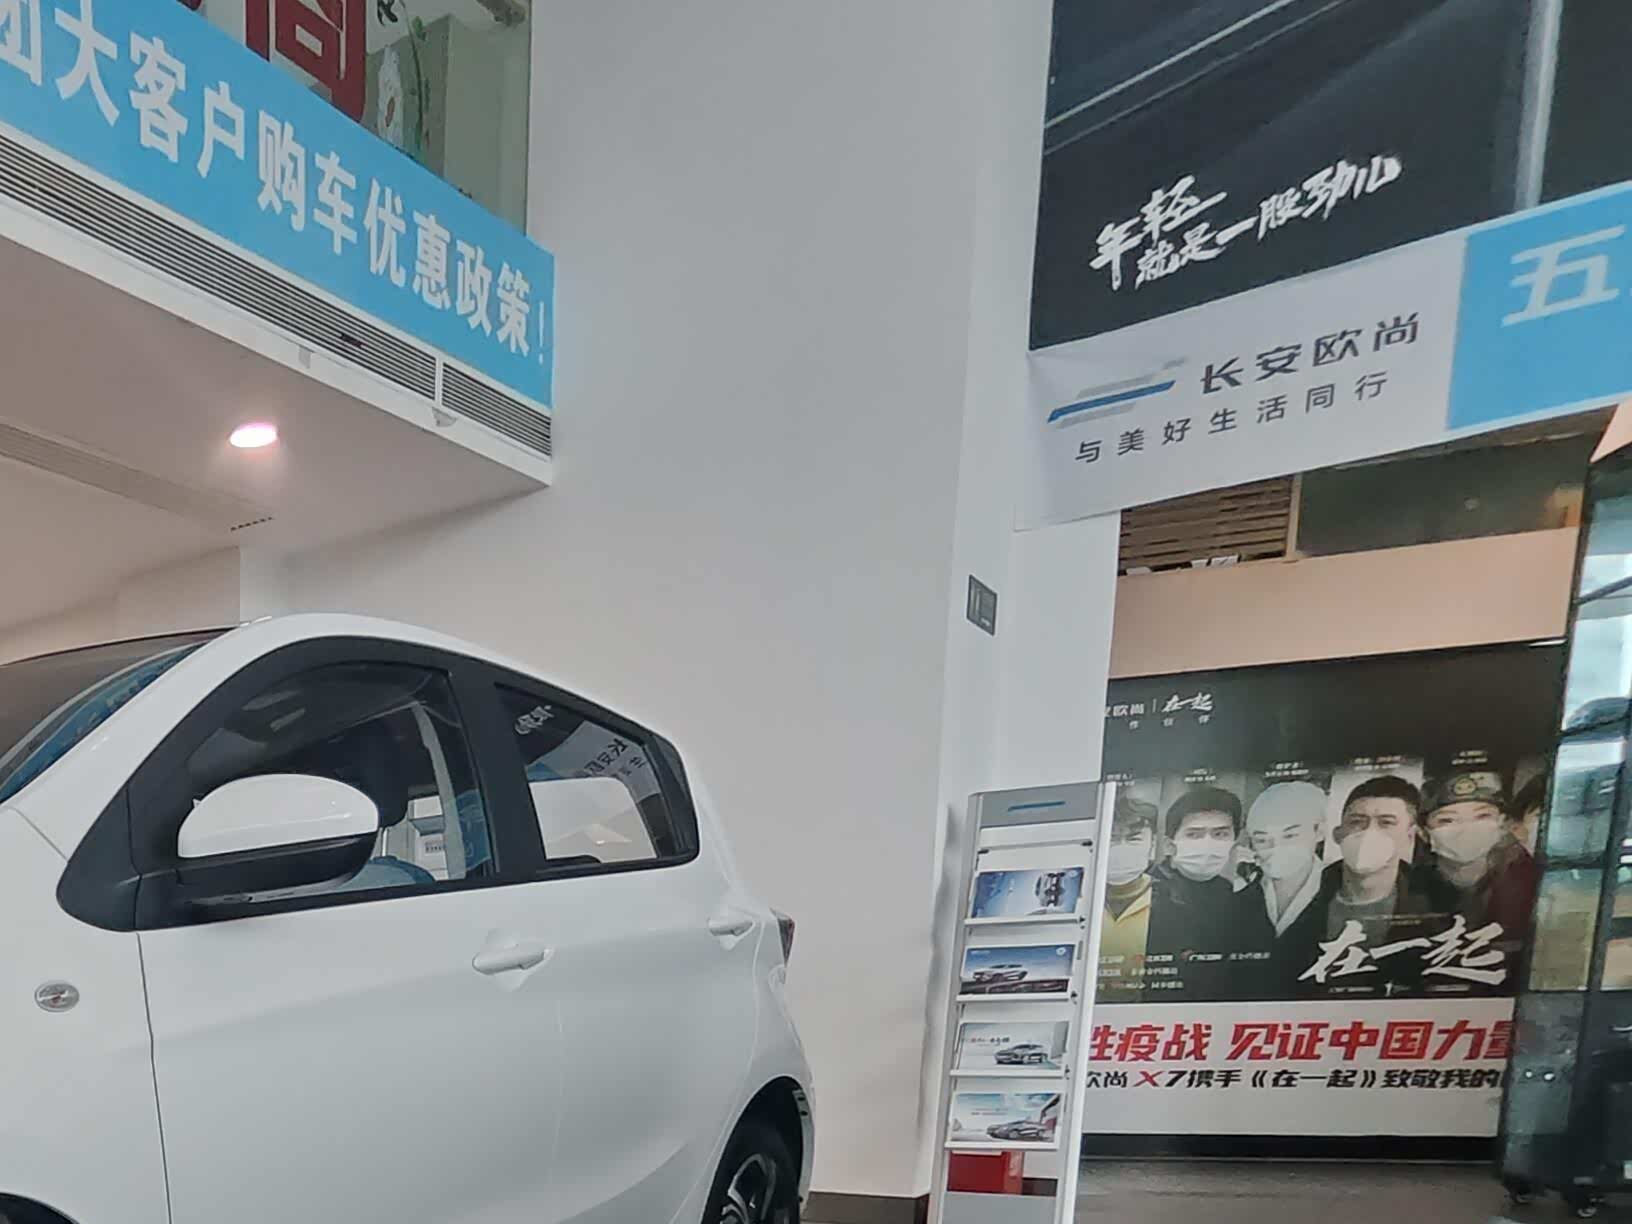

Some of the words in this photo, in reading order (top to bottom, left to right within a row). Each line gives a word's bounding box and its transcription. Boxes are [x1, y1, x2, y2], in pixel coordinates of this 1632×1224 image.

[1089, 174, 1228, 290] 年轻
[1500, 224, 1627, 327] 五
[1200, 312, 1419, 394] 长安欧尚
[1074, 370, 1388, 464] 与美好生活同行
[1297, 914, 1507, 986] 在一起
